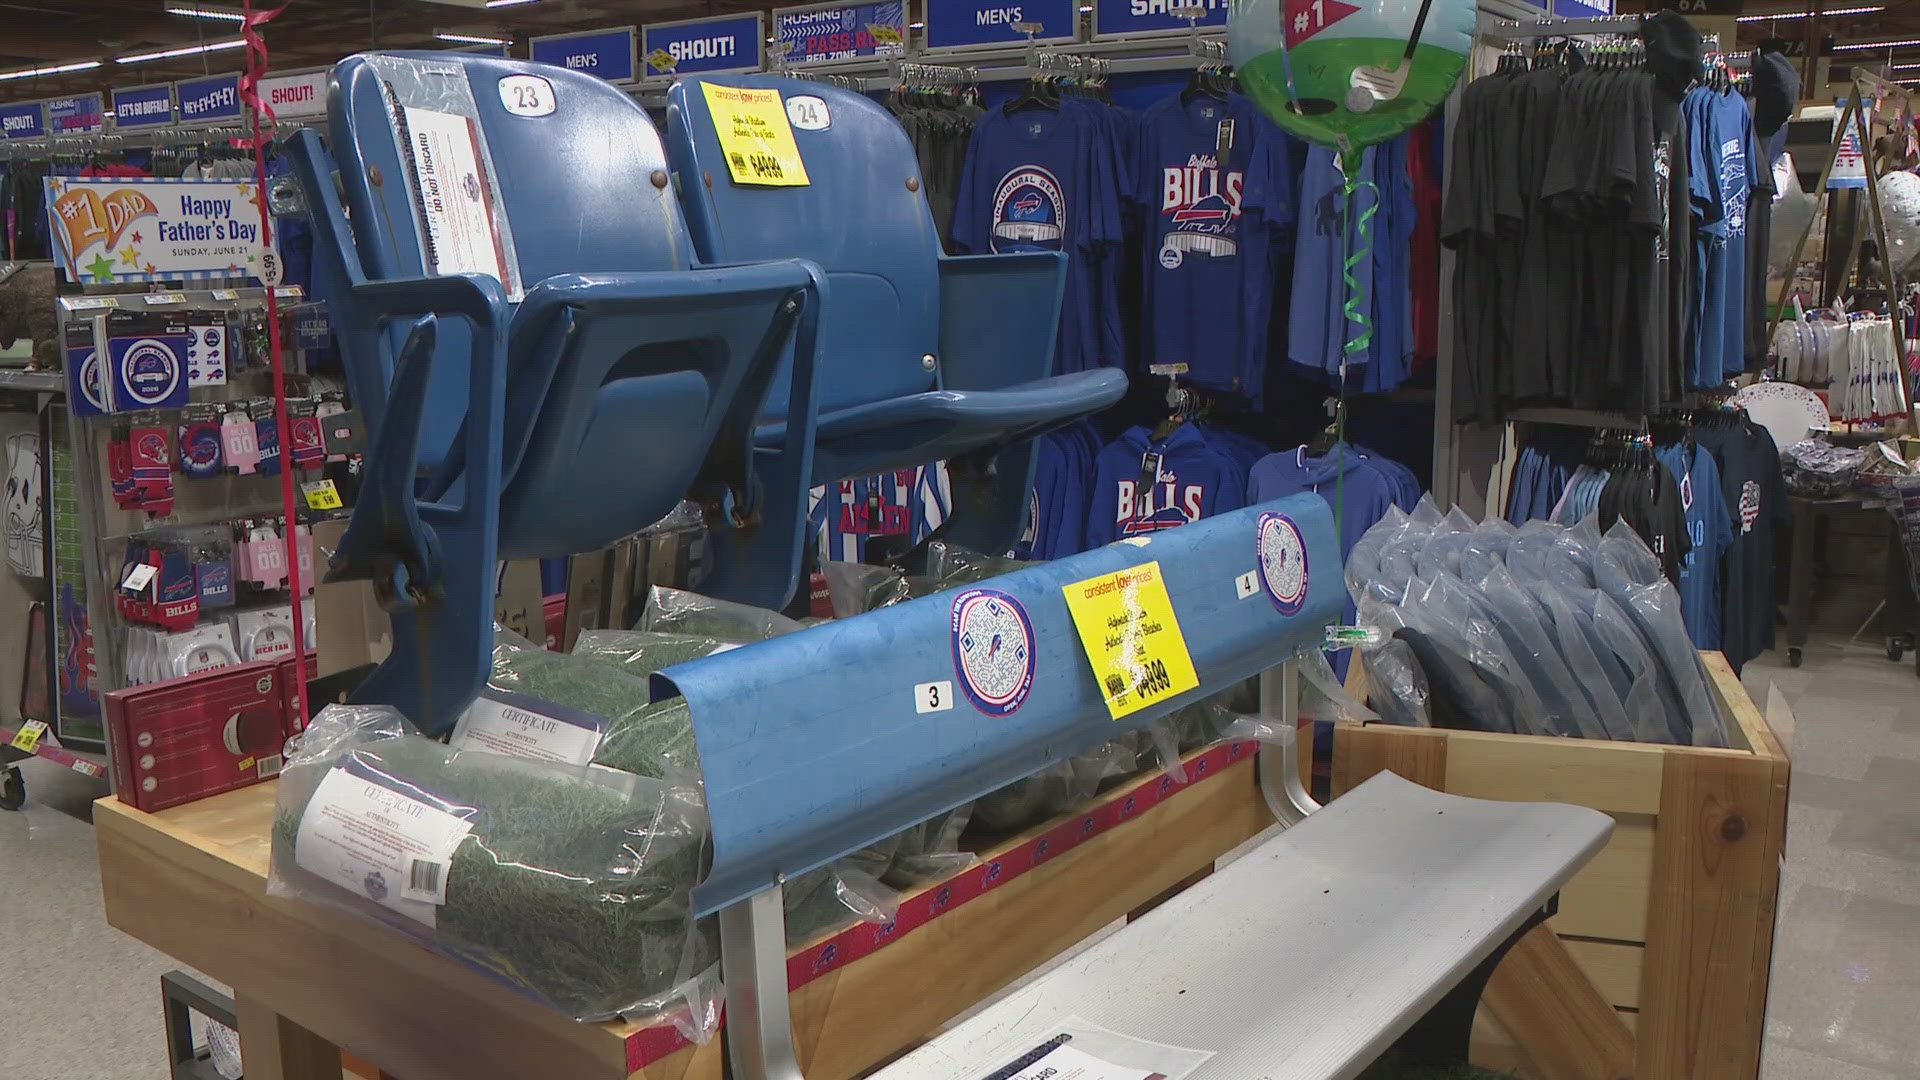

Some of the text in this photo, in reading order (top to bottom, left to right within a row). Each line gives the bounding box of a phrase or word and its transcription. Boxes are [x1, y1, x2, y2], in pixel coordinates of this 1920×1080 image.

[783, 9, 840, 26] RUSHING
[977, 7, 1023, 26] MEN'S
[1131, 0, 1228, 16] SHO
[1293, 0, 1326, 33] #1
[668, 36, 735, 61] SHOUT!
[566, 53, 598, 69] MEN'S
[184, 87, 235, 114] HEY-EY-EY-EY
[271, 85, 314, 104] SHOUT!
[513, 86, 539, 108] 23
[118, 103, 134, 117] LET'S
[134, 102, 144, 116] GO
[798, 104, 818, 123] 24
[2, 114, 34, 130] SHOUT!
[418, 133, 443, 213] DO NOT DISCARD
[1187, 154, 1218, 173] Buffalo
[994, 175, 1063, 222] INAUGURAL SEASON
[1162, 167, 1244, 217] BILLS
[61, 193, 146, 237] #1 DAD
[181, 195, 231, 219] Happy
[158, 220, 257, 243] Father's Day
[172, 246, 248, 257] SUNDAY, JUNE 21
[231, 435, 254, 455] 00
[1117, 480, 1204, 524] BILLS
[838, 499, 912, 534] ALEN
[203, 585, 228, 595] BILLS
[1084, 578, 1117, 600] consistent
[1244, 576, 1251, 592] 4
[165, 602, 198, 617] BILLS
[929, 686, 939, 707] 3
[501, 708, 560, 734] CERTIFICATE
[363, 785, 427, 819] CERICATE
